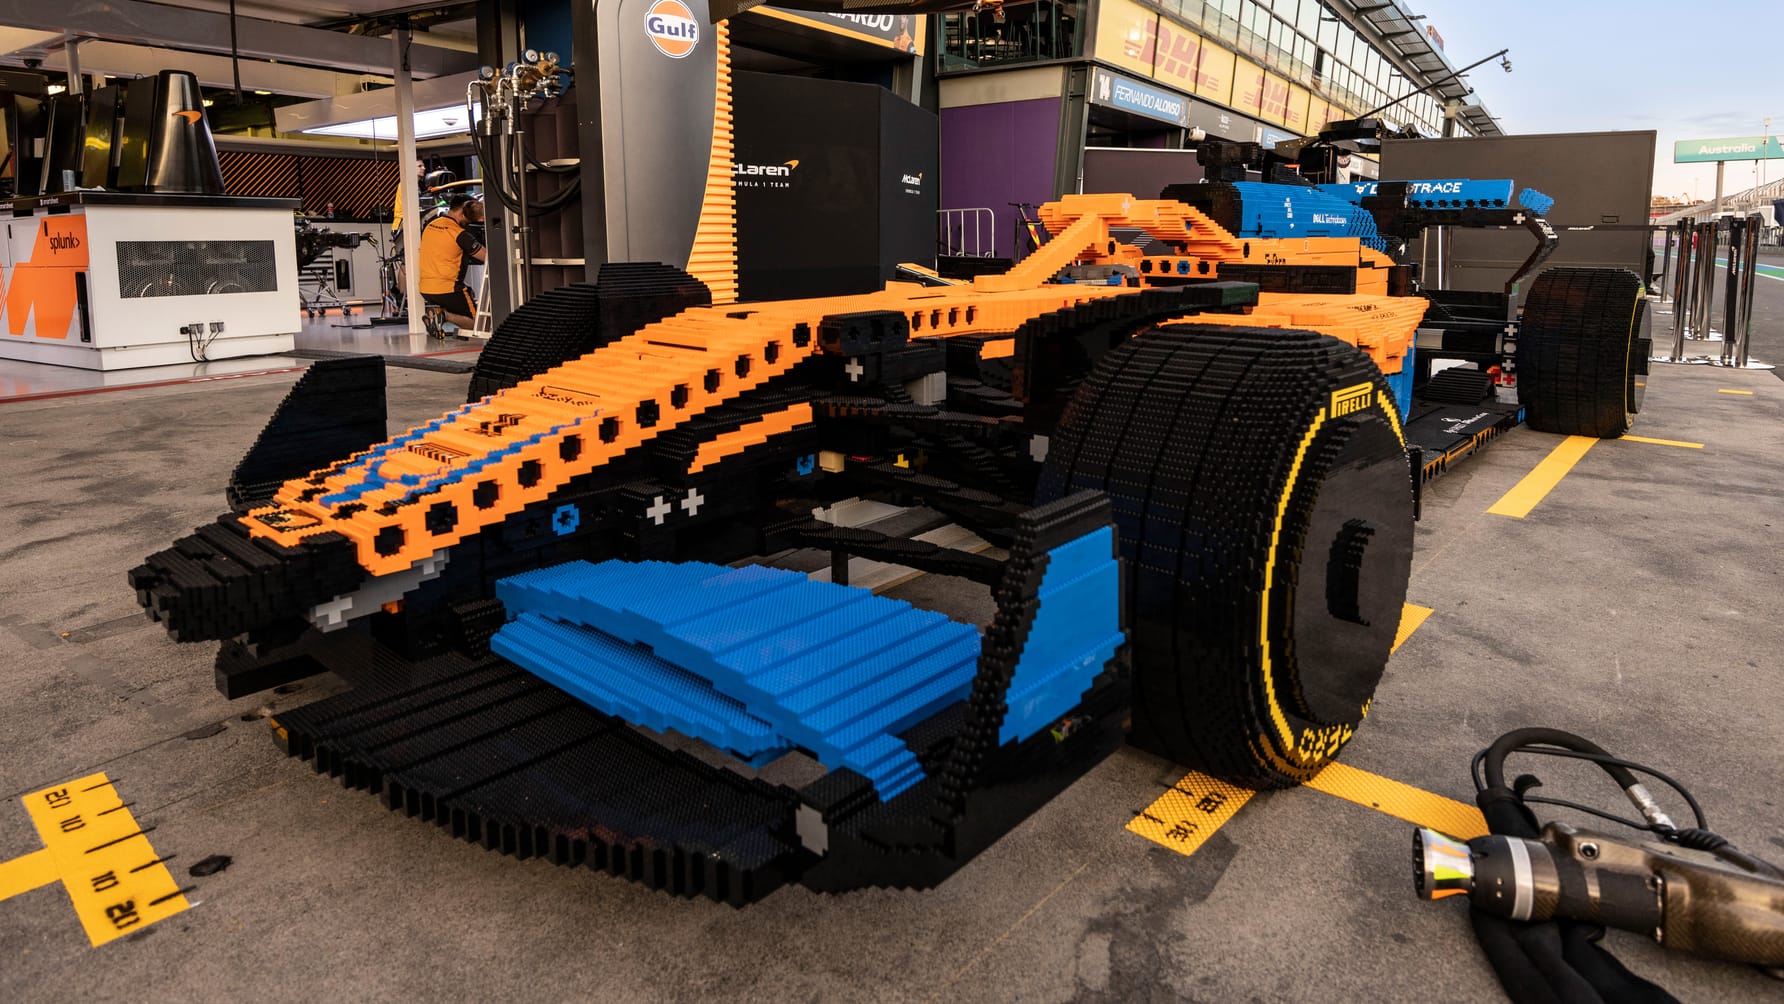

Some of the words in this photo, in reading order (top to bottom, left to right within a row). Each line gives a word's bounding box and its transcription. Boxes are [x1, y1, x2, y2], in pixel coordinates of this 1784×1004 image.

[648, 16, 696, 39] Gulf
[1139, 18, 1209, 87] DHL
[1099, 73, 1111, 101] 14
[1114, 84, 1155, 109] FERNANDO
[1153, 98, 1181, 116] ALONSO
[1251, 74, 1293, 119] DHL
[1698, 143, 1756, 155] Australia
[731, 163, 790, 176] cLaren
[1330, 381, 1374, 419] PIRELLI
[45, 788, 72, 809] 20
[60, 814, 87, 833] 10
[91, 870, 120, 893] 10
[105, 899, 141, 930] 20
